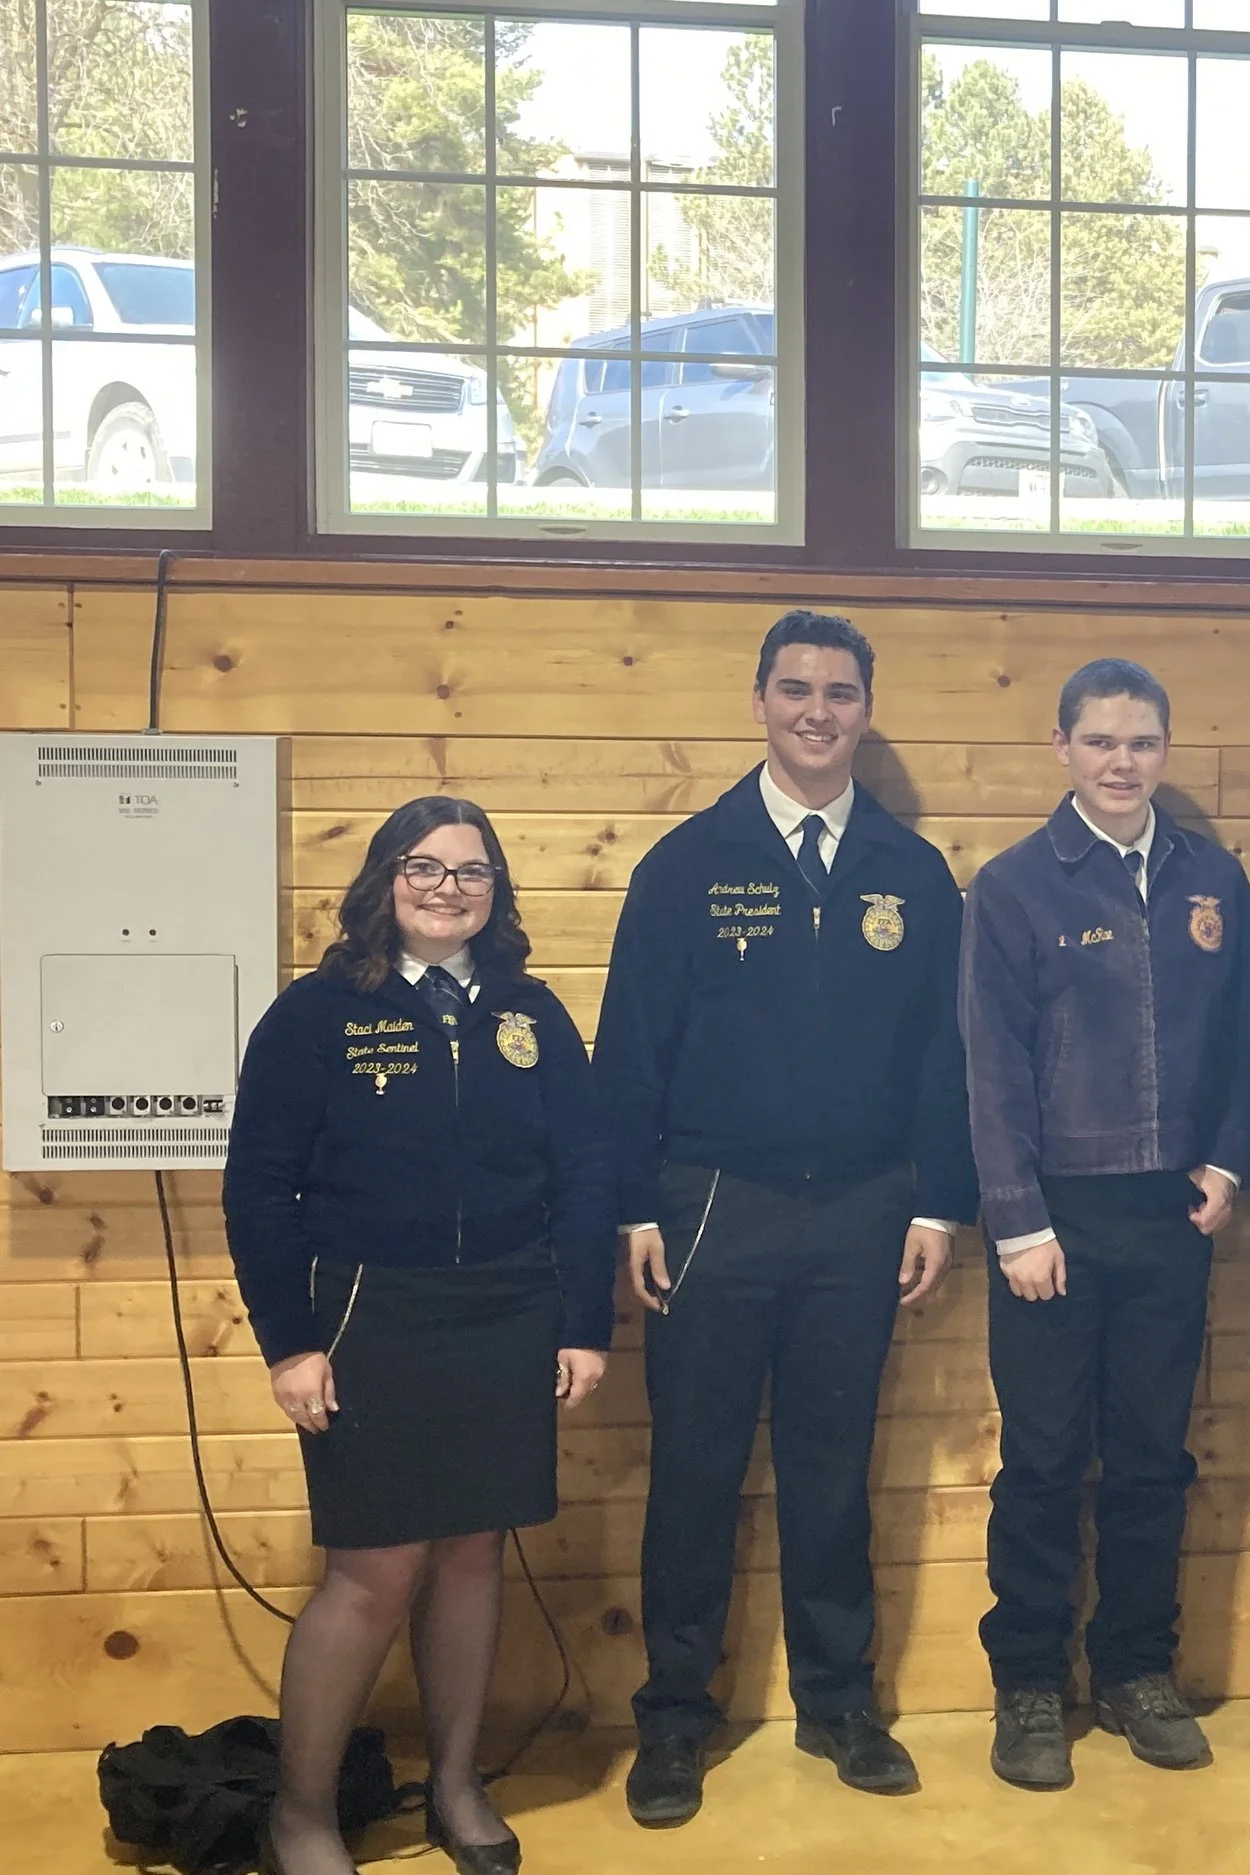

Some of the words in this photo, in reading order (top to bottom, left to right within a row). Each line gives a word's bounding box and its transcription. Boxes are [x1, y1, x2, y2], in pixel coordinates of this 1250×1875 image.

[734, 903, 782, 917] President
[345, 1022, 372, 1036] Staci
[377, 1041, 419, 1053] Sentinel
[352, 1062, 418, 1074] 2023-2024
